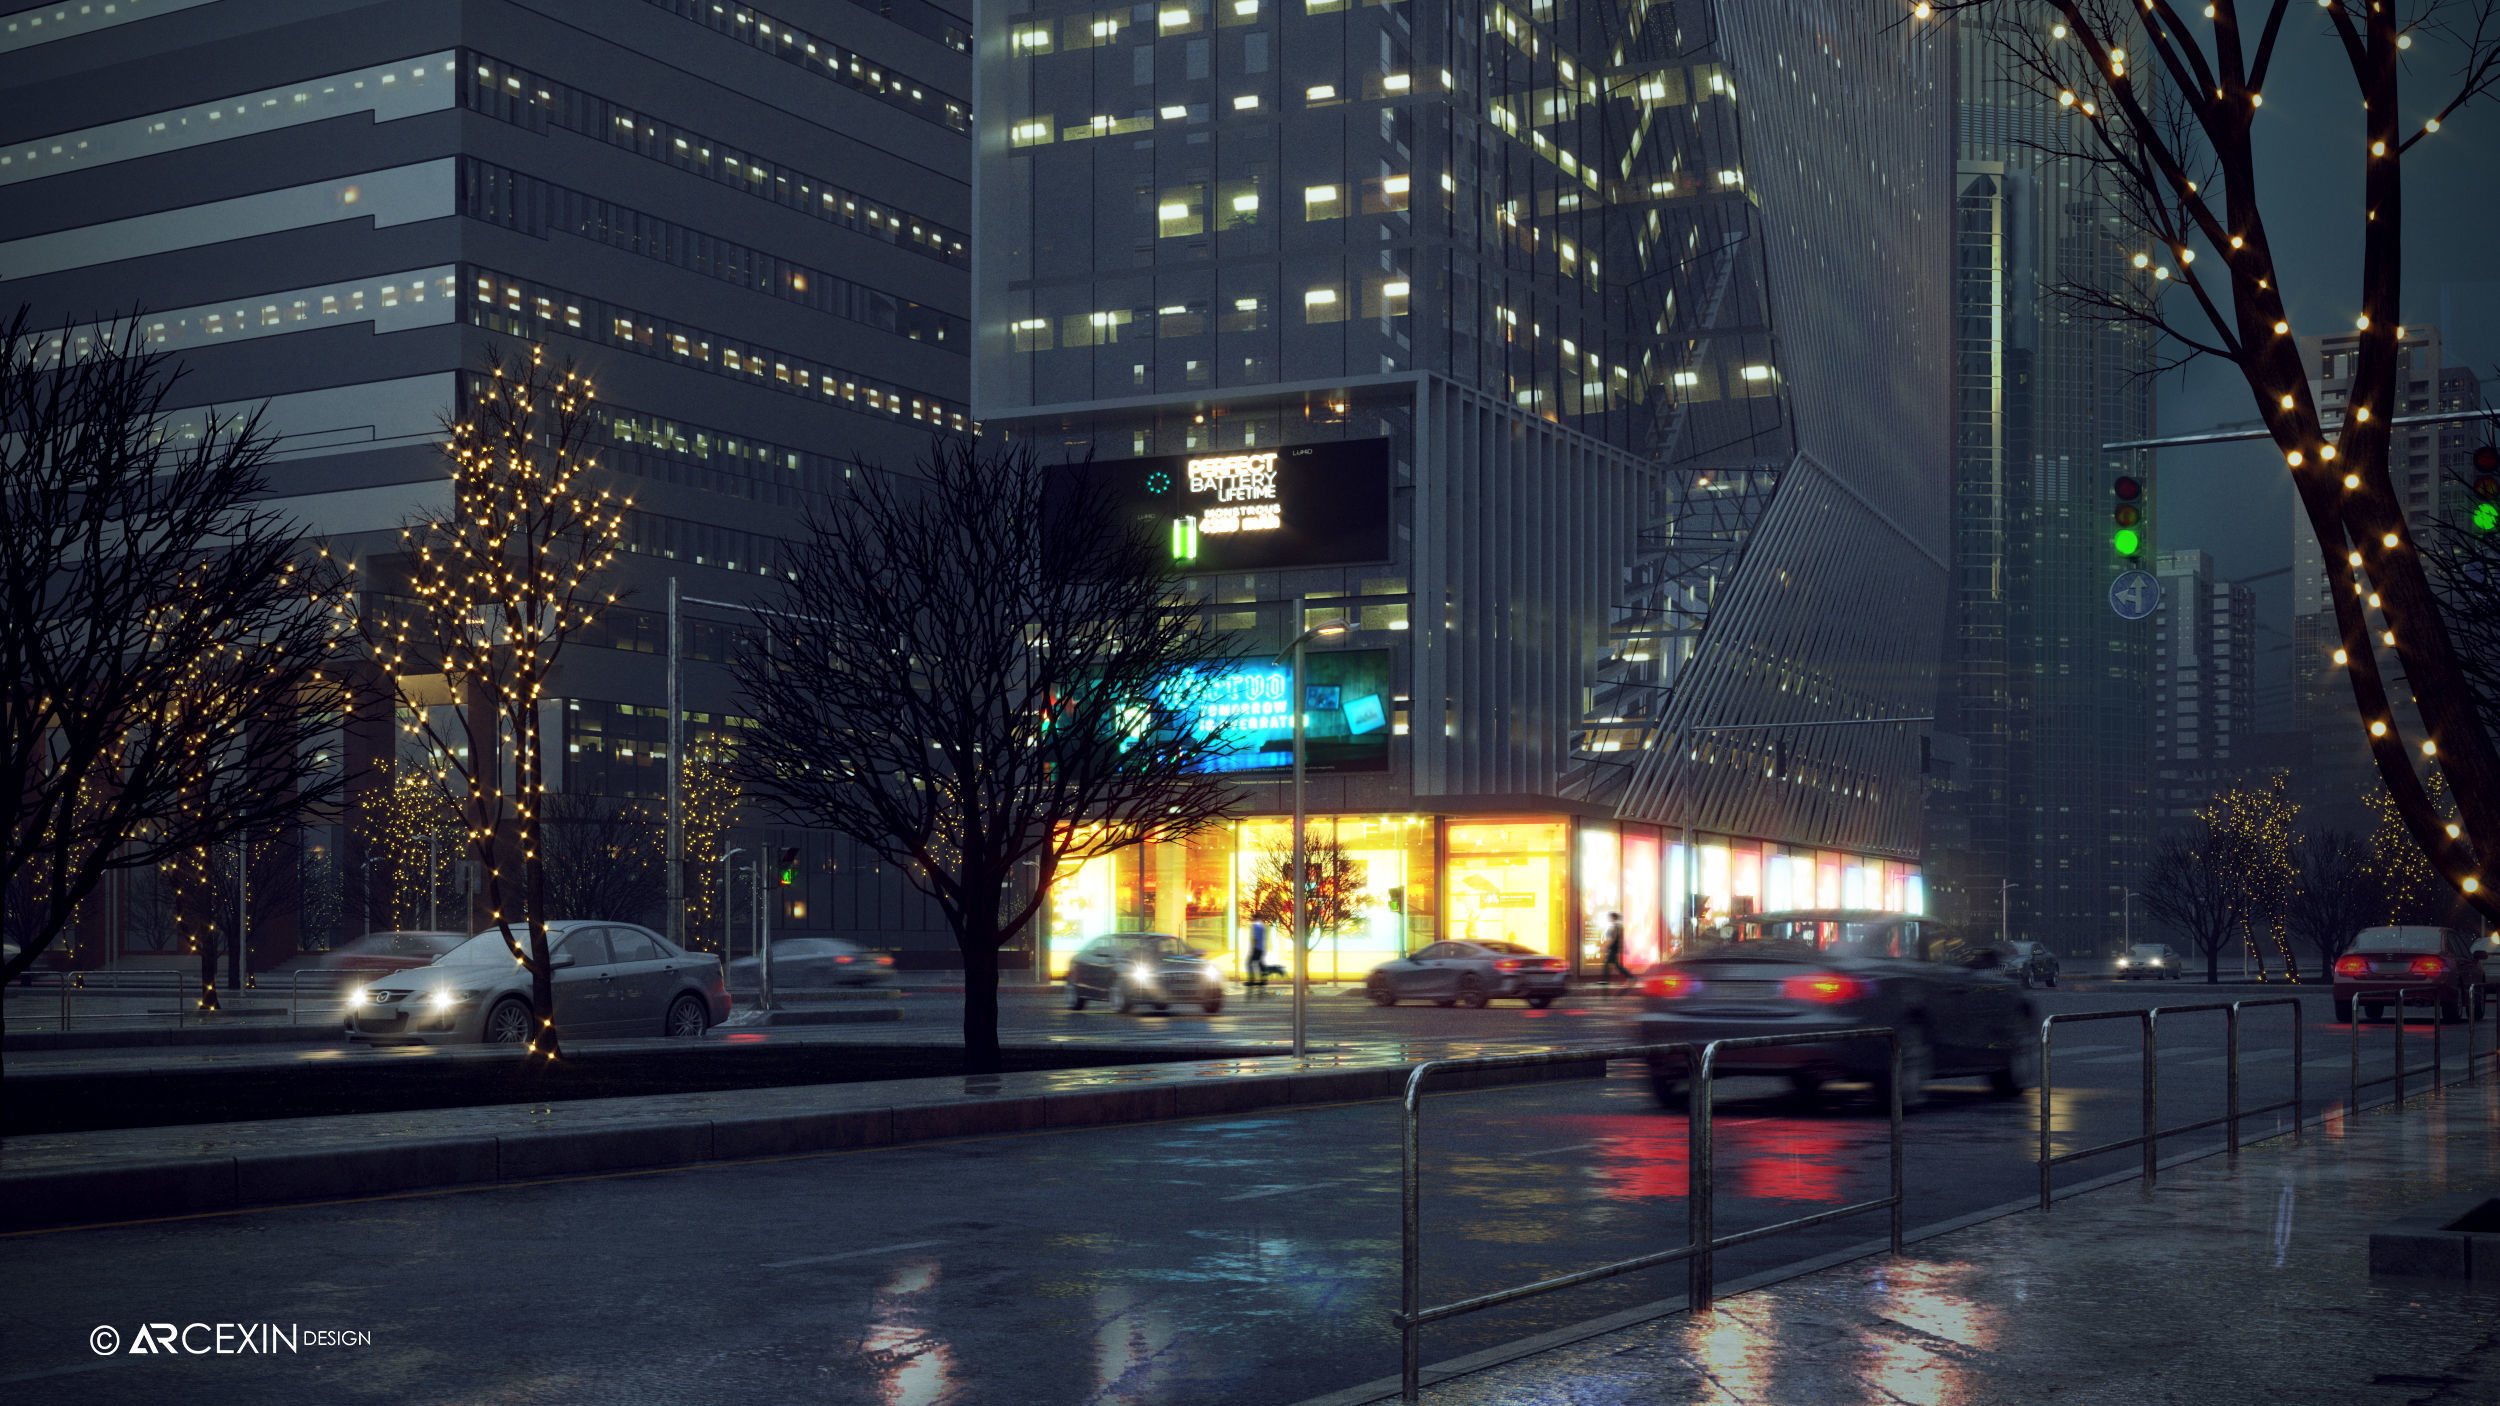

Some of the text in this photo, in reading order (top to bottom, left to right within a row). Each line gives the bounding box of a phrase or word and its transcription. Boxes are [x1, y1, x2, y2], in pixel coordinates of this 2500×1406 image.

[1188, 453, 1278, 478] PERFECT
[1190, 473, 1277, 492] BATTERY
[1218, 485, 1276, 502] LIFETIME
[1204, 504, 1281, 518] MONSTROUS
[1200, 701, 1287, 717] TOMORROW
[1200, 719, 1215, 731] IS
